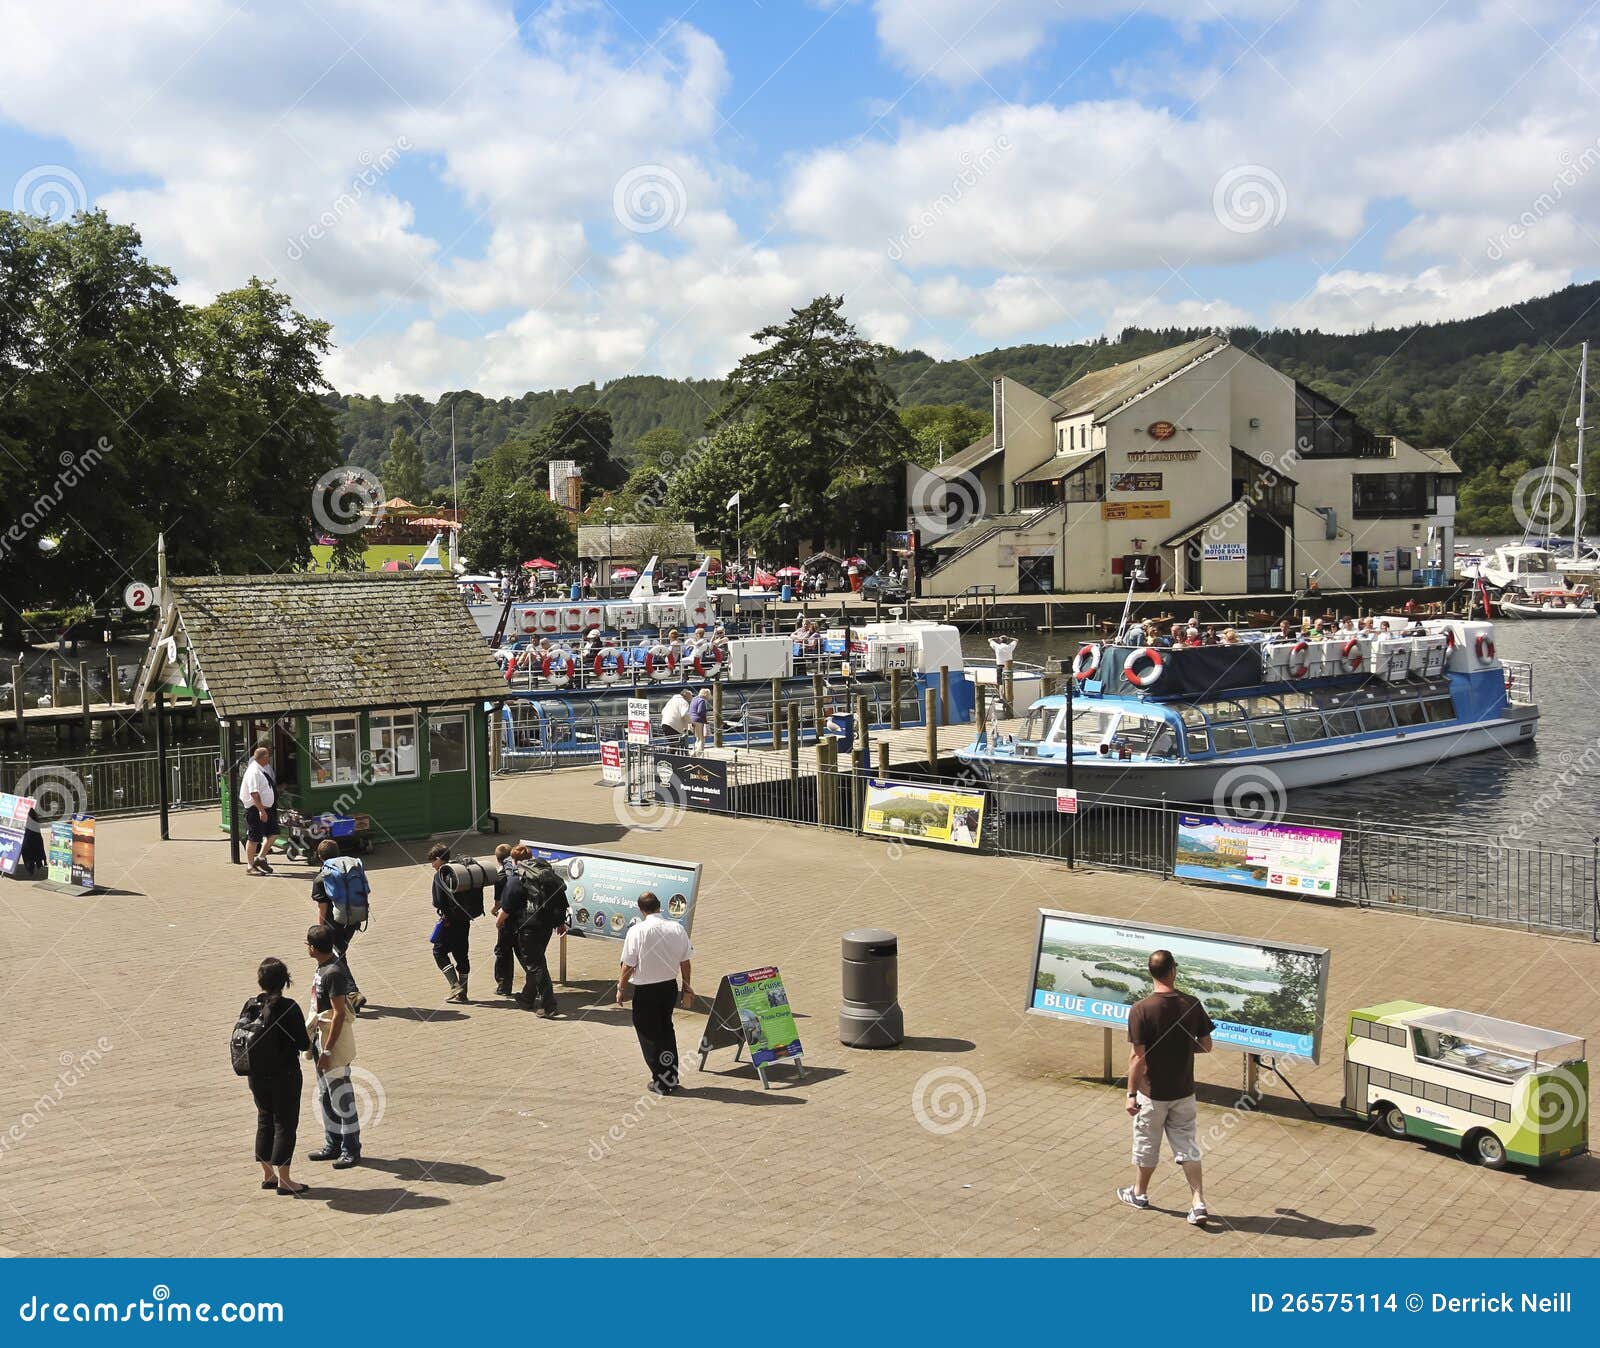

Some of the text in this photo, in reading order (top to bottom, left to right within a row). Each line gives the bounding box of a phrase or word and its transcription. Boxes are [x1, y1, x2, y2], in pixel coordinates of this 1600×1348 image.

[133, 590, 145, 606] 2
[889, 660, 905, 668] RFD
[1223, 824, 1258, 836] Freedom
[1261, 829, 1270, 837] of
[1272, 829, 1285, 839] the
[1288, 831, 1309, 842] Lake
[1311, 833, 1338, 845] Ticket
[592, 893, 620, 906] England's
[735, 981, 781, 997] Buffet Cruise
[1044, 993, 1085, 1012] BLUE
[1221, 1023, 1248, 1034] Circular
[1250, 1027, 1273, 1038] Cruise
[1216, 1031, 1228, 1040] part
[1250, 1036, 1265, 1045] Lake
[1273, 1041, 1296, 1049] Islands
